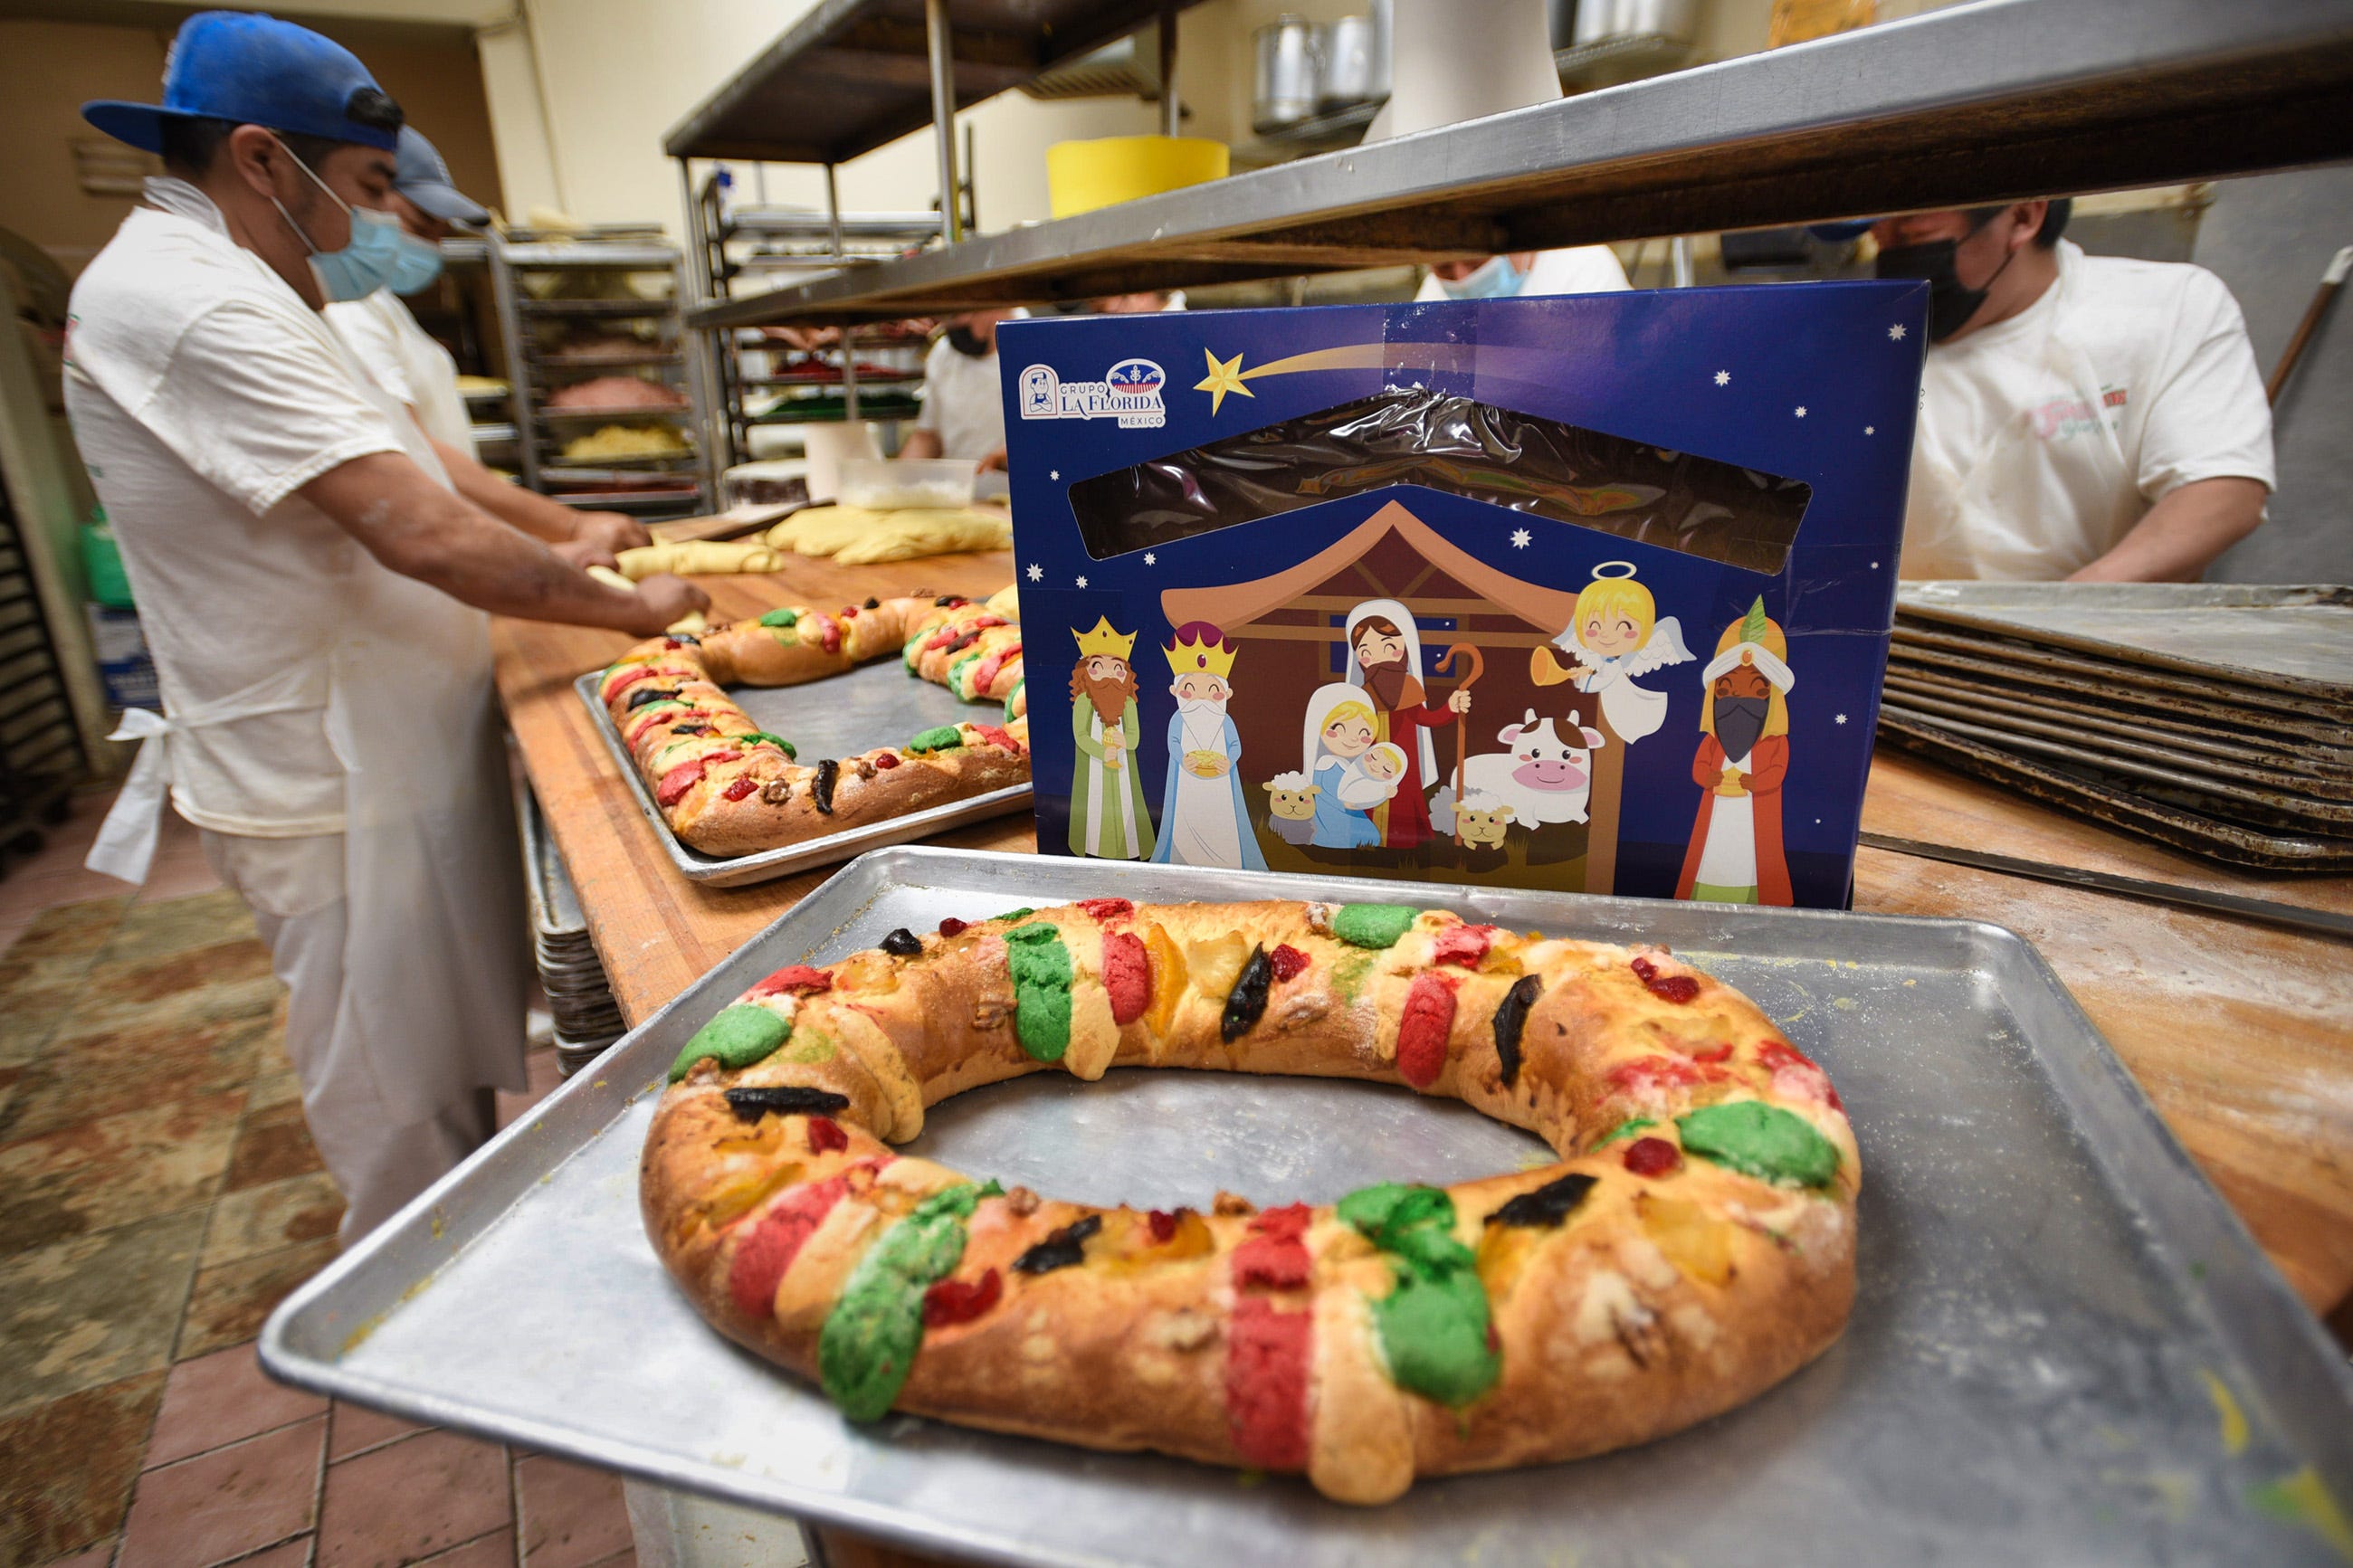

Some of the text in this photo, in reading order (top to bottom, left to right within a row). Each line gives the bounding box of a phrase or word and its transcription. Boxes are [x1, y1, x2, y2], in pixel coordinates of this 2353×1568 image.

[1060, 385, 1105, 394] GRUPO
[1062, 394, 1162, 416] LA FLORIDA
